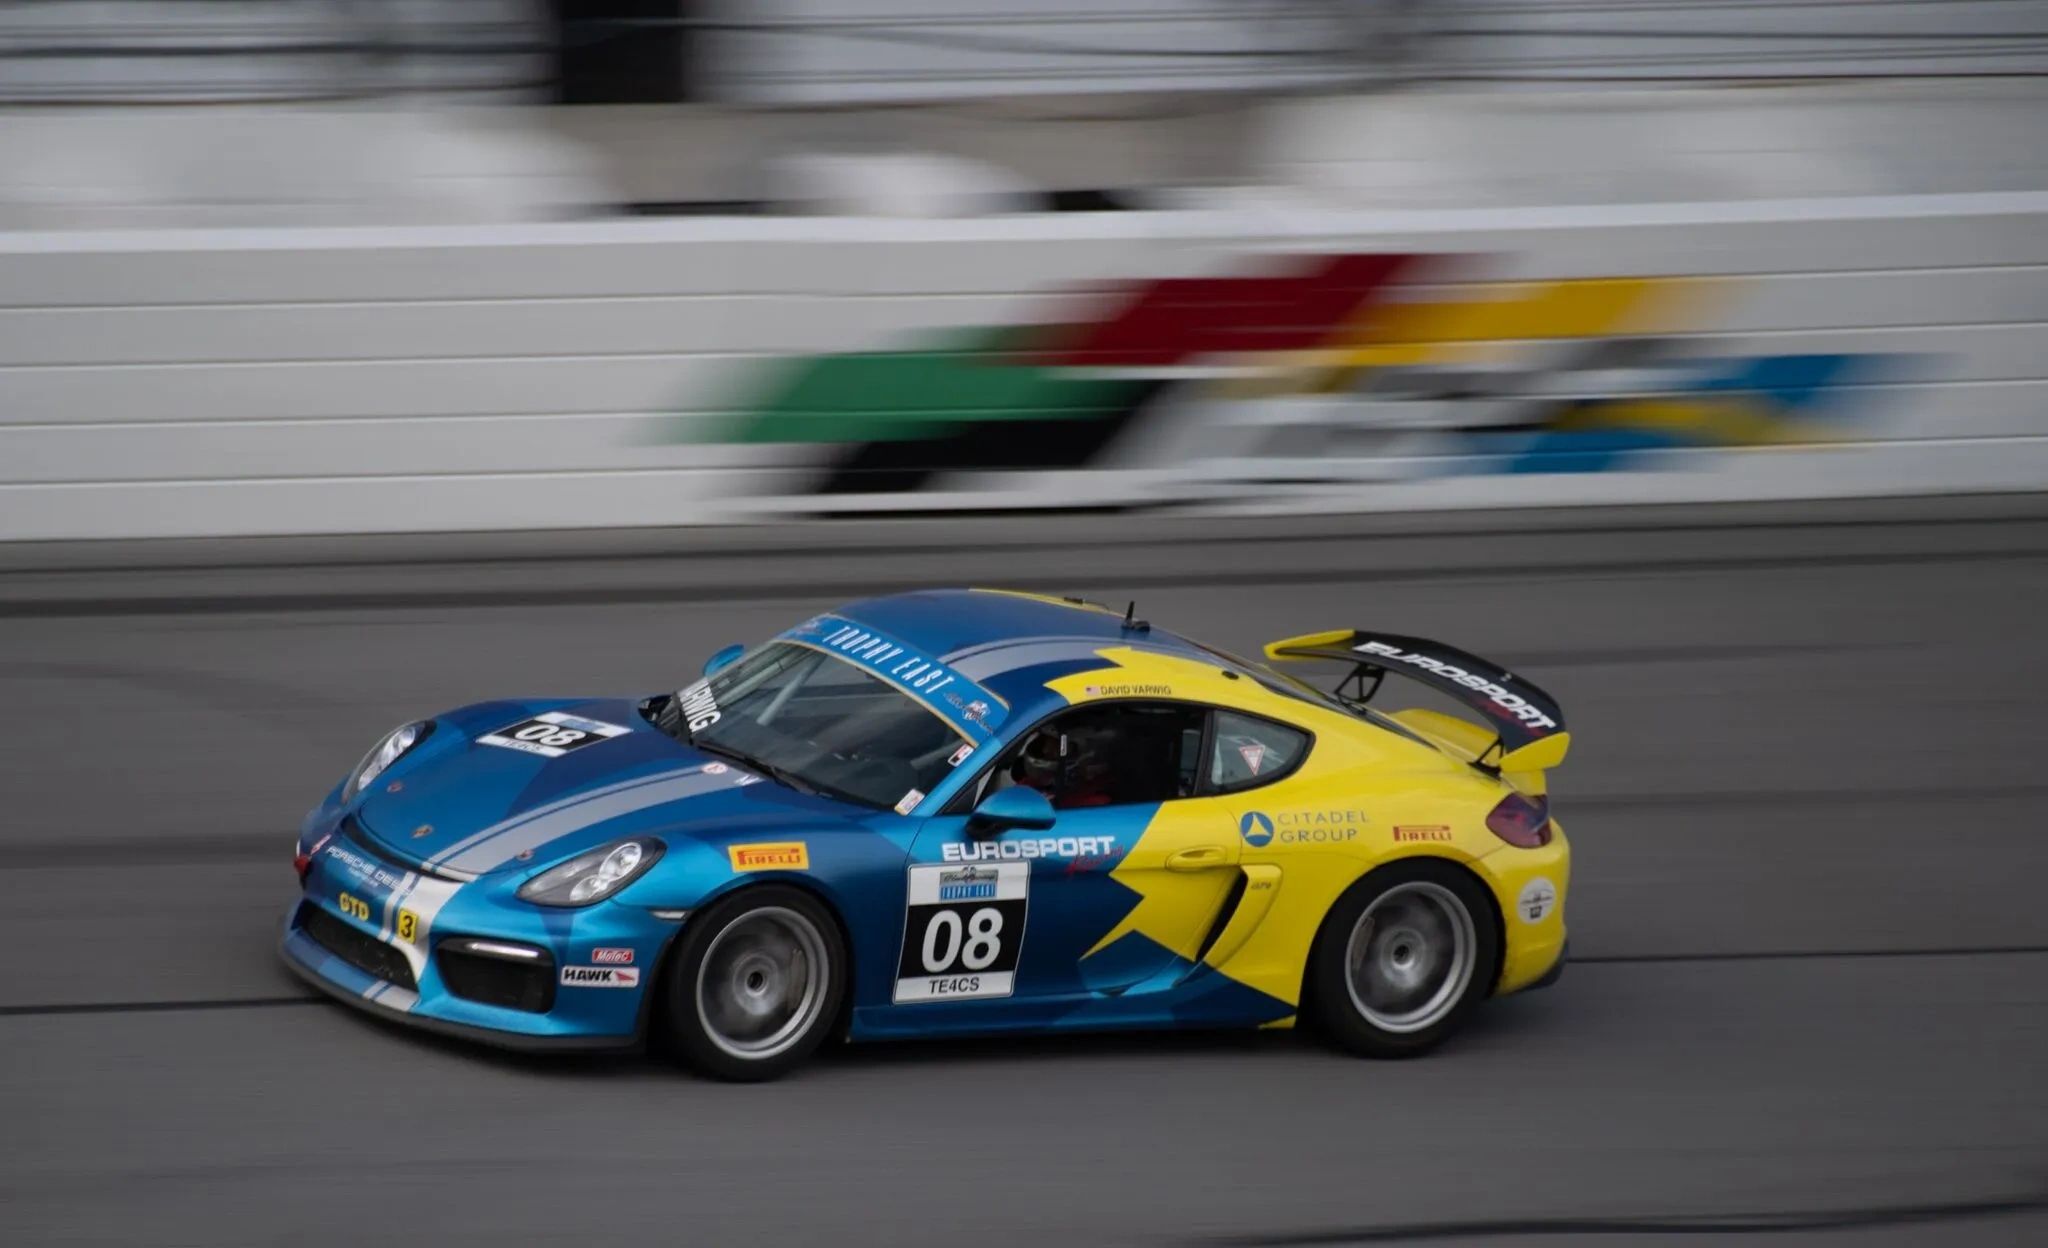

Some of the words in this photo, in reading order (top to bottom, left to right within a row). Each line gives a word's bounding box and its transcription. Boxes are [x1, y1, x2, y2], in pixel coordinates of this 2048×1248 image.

[822, 625, 904, 665] TROPHY
[891, 656, 955, 694] EAST
[1100, 685, 1130, 696] DAVID
[1132, 685, 1171, 696] VARWIG
[1352, 640, 1557, 729] EUROSPORT
[514, 724, 586, 746] 08
[1277, 809, 1370, 826] CITADEL
[1280, 828, 1358, 843] GROUP
[1393, 825, 1452, 842] PIRELLI
[736, 848, 801, 866] PIRELLI
[942, 836, 1115, 862] EUROSPORT
[326, 845, 376, 875] PORSCHE
[400, 914, 414, 939] 3
[921, 907, 1004, 974] 08
[563, 968, 614, 983] HAWK
[928, 976, 980, 994] TE4CS
